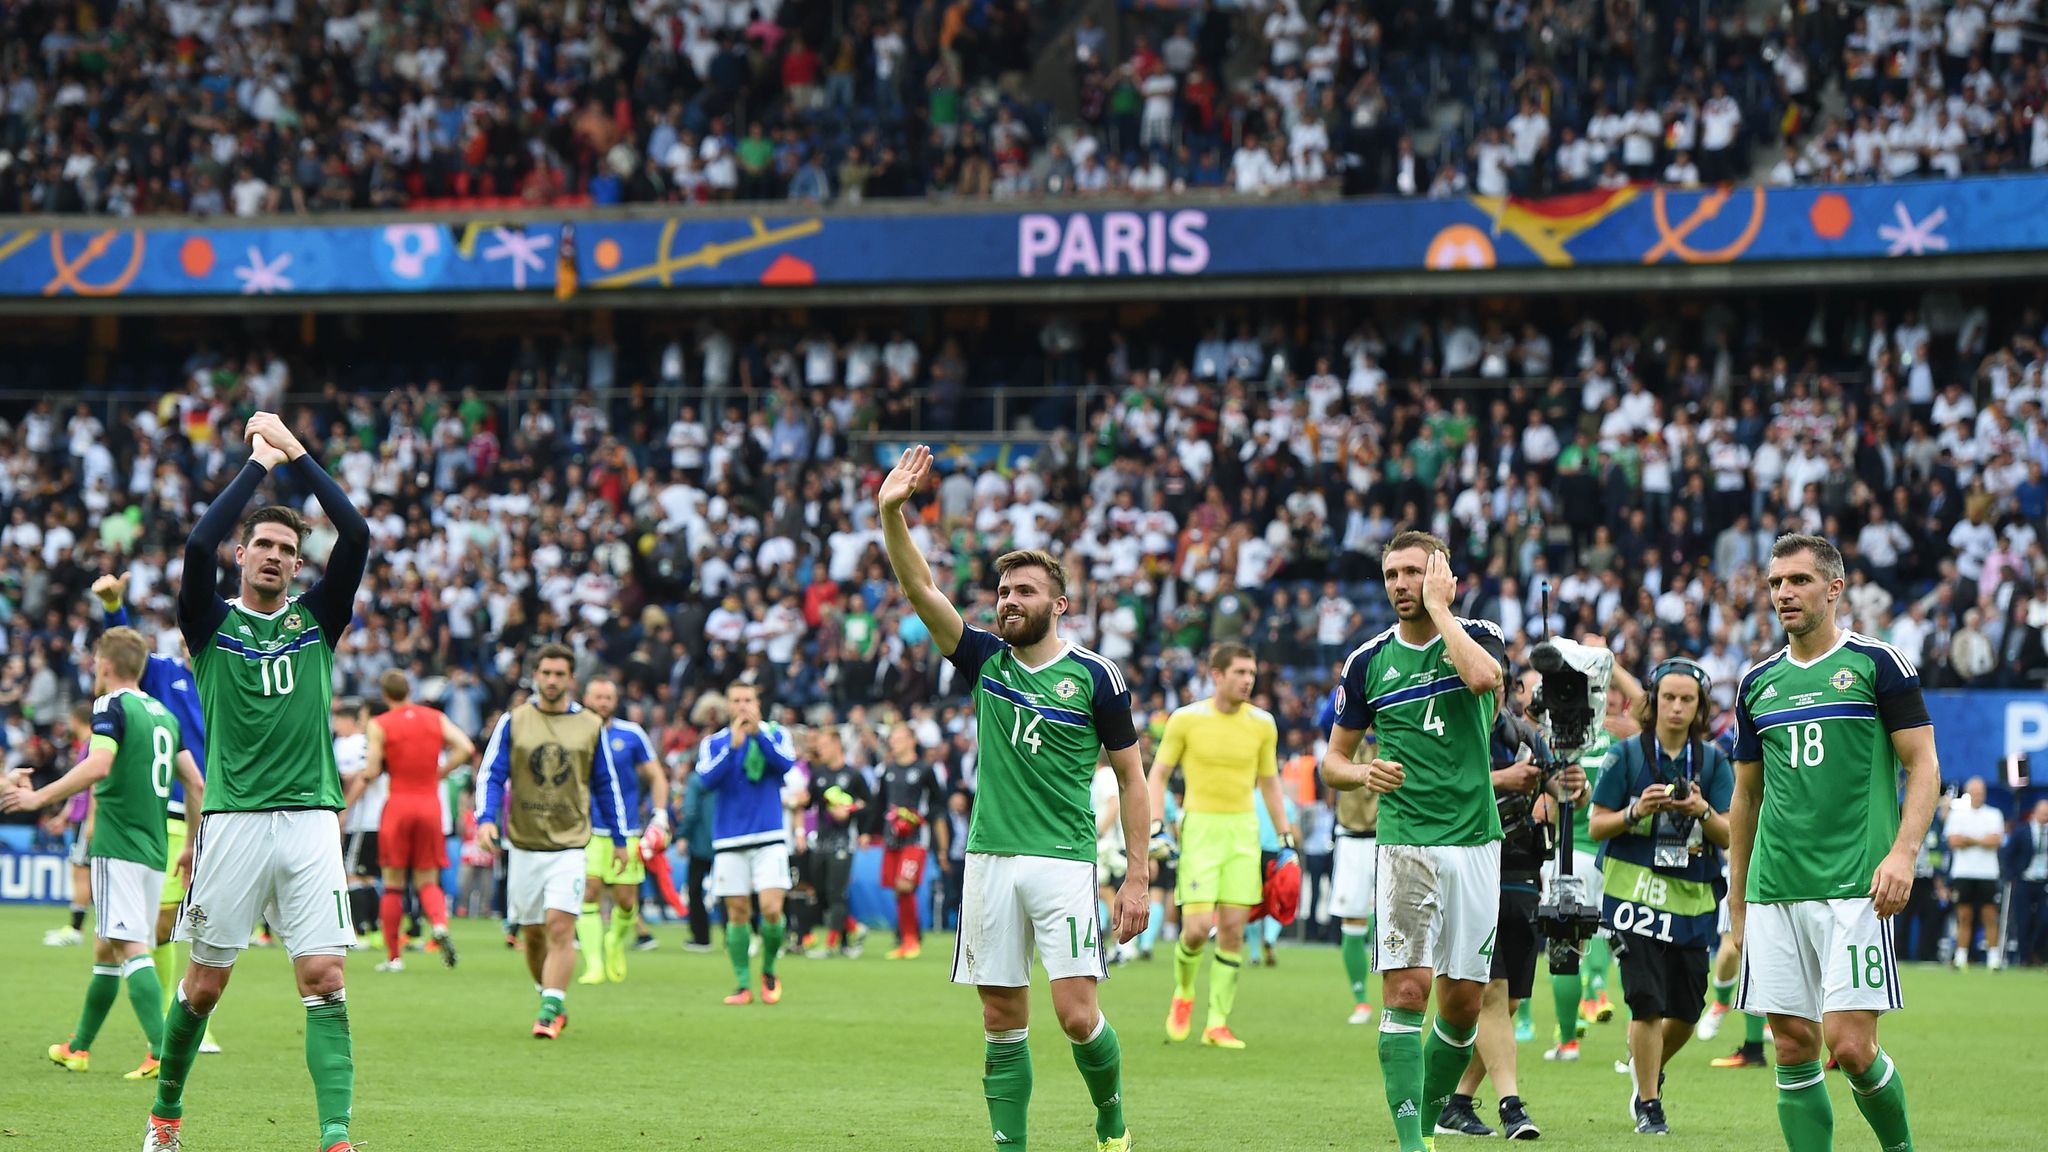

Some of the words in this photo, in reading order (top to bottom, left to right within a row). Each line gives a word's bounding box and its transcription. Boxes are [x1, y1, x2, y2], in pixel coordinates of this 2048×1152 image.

[1018, 208, 1210, 277] PARIS
[260, 655, 294, 696] 10
[1011, 706, 1042, 754] 14
[1423, 697, 1445, 736] 4
[152, 725, 174, 798] 8
[1787, 722, 1824, 768] 18
[1632, 871, 1667, 906] HB
[1066, 917, 1097, 958] 14
[1613, 901, 1674, 943] 021
[1478, 926, 1496, 964] 4
[1847, 945, 1884, 989] 18
[1397, 1109, 1418, 1119] adidas
